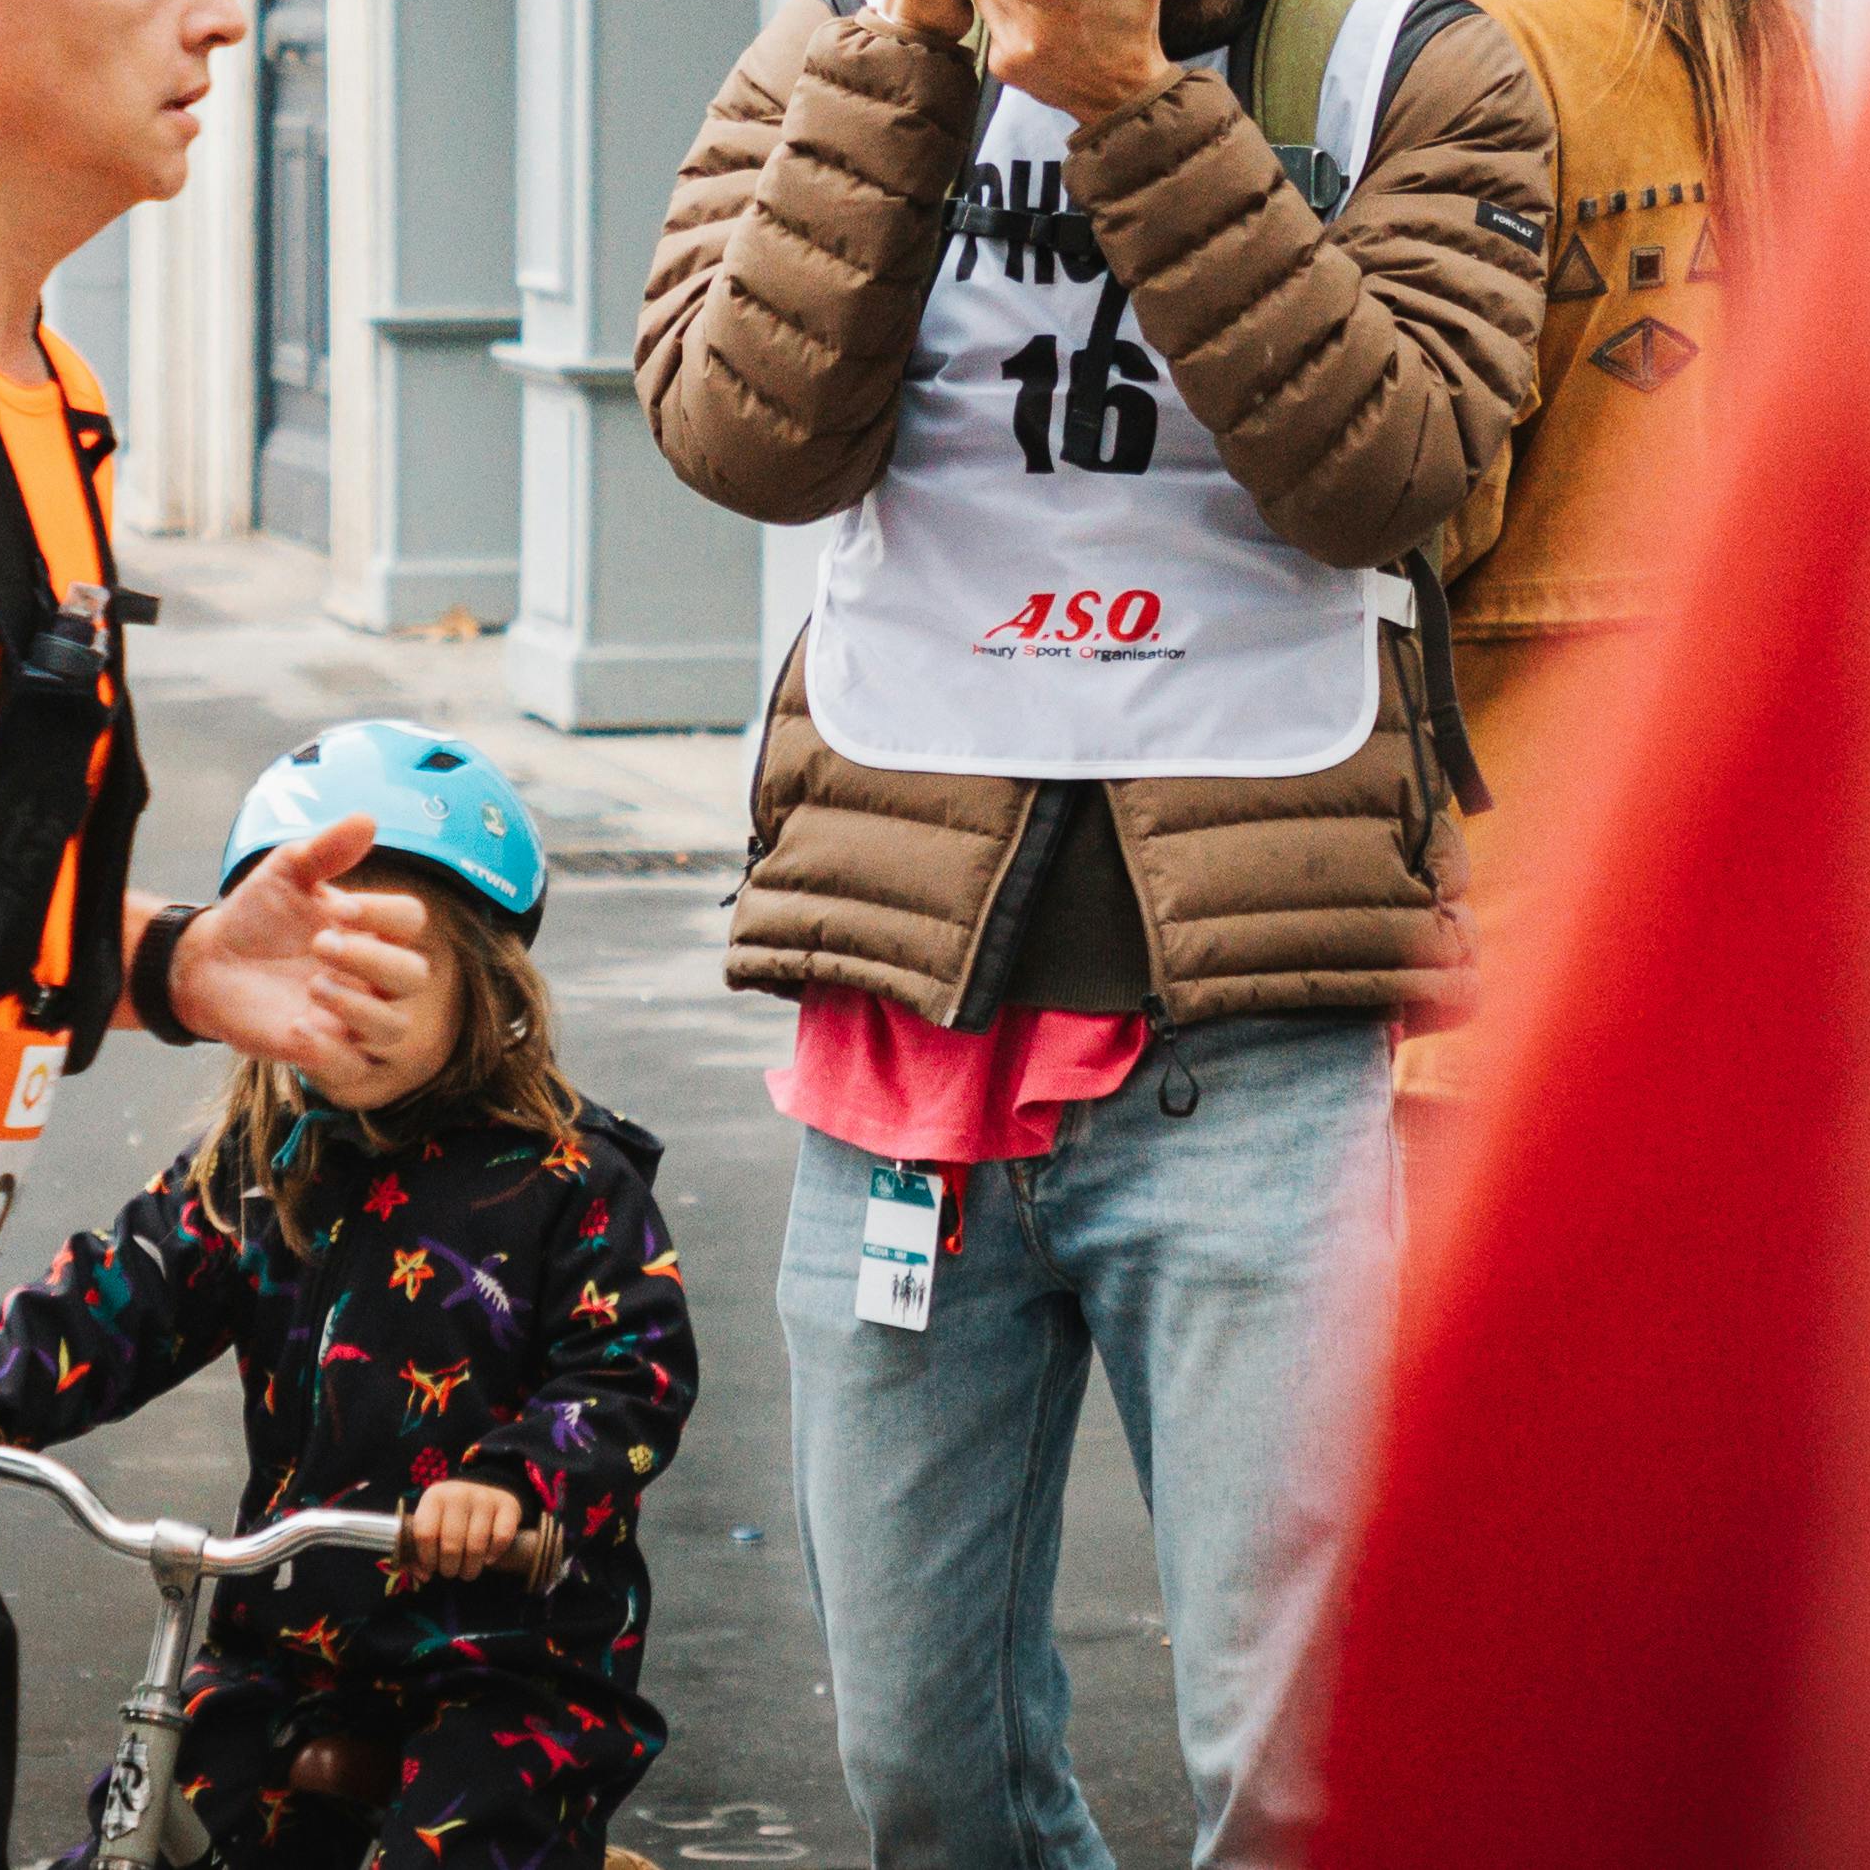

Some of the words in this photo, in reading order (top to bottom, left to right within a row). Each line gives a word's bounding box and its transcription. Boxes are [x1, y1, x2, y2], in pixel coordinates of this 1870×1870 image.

[1492, 213, 1533, 239] FORCLAZ
[1001, 334, 1159, 475] 16
[984, 589, 1162, 643] A.S.O.
[1023, 644, 1072, 659] Sport
[1079, 646, 1186, 663] Organisation
